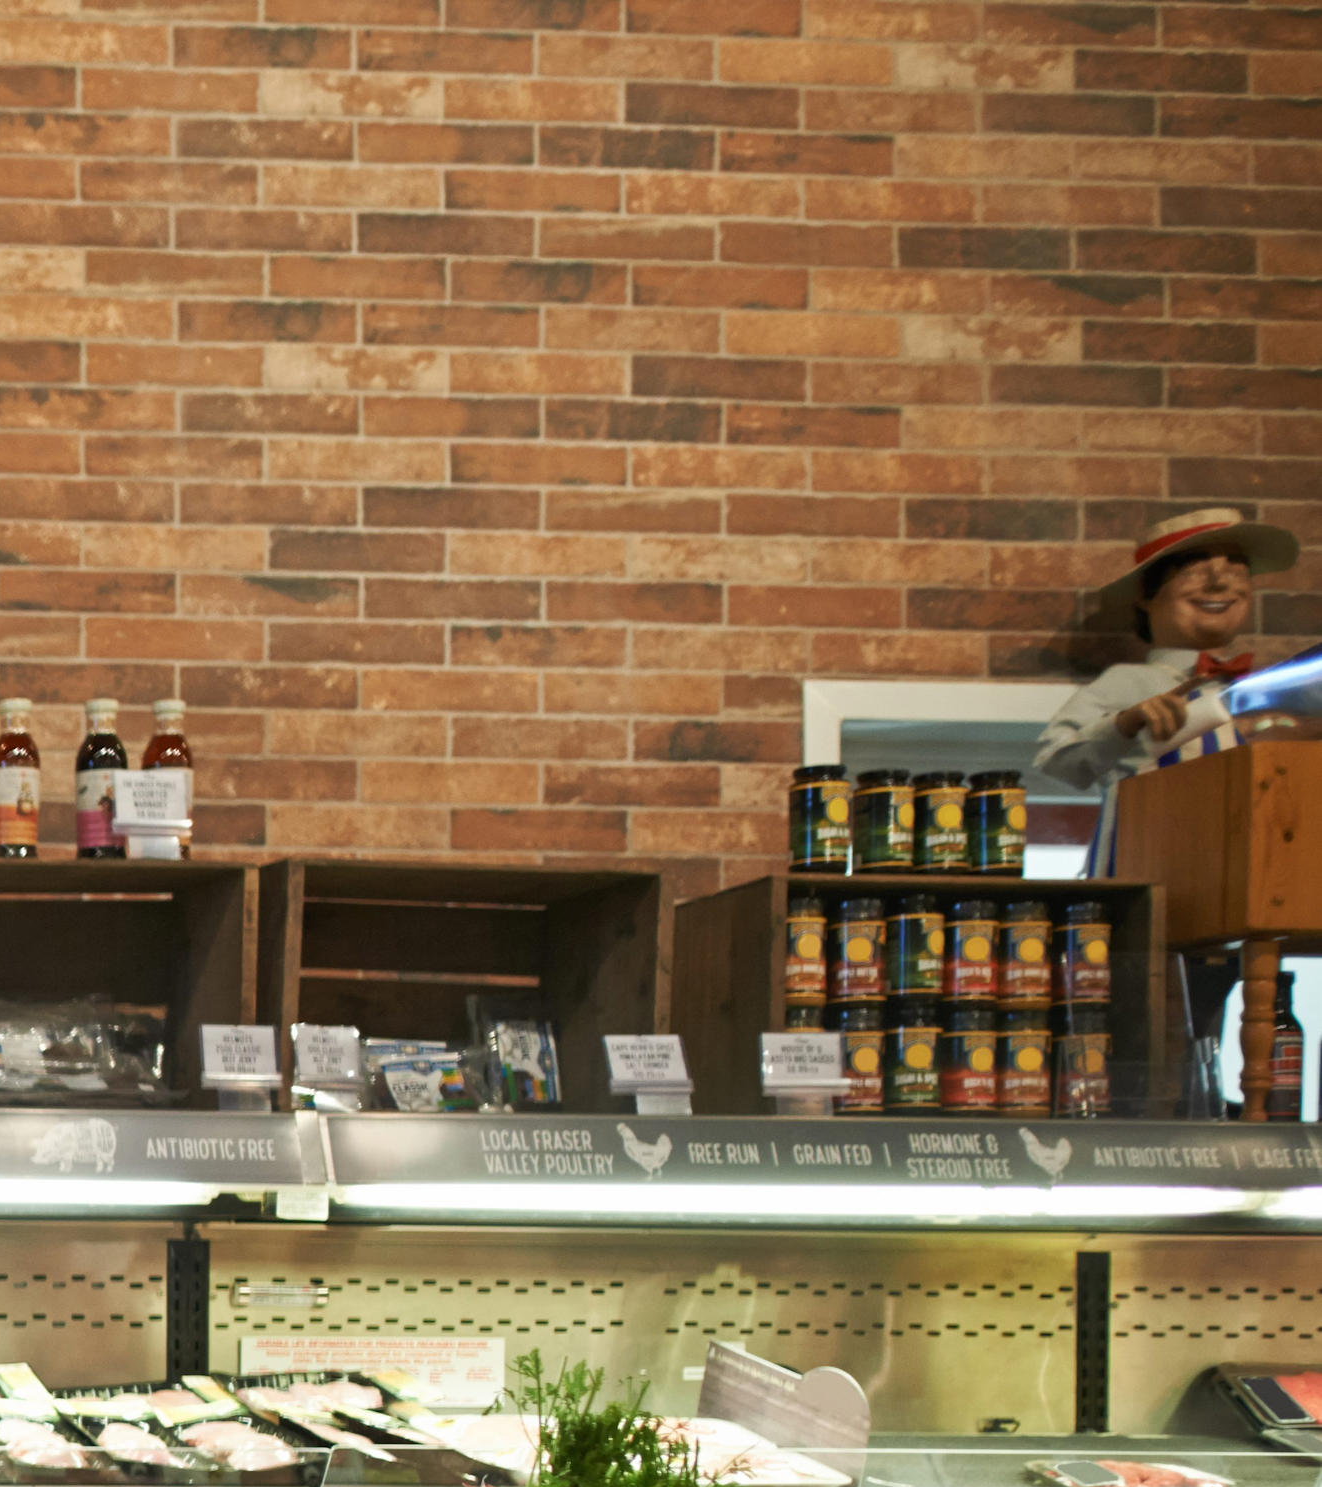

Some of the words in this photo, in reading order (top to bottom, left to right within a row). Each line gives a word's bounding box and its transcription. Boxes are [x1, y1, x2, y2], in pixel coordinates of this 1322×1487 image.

[146, 1137, 236, 1161] ANTIBIOTIC
[239, 1138, 277, 1162] FREE
[481, 1130, 530, 1152] LOCAL
[532, 1130, 594, 1152] FRASER
[909, 1133, 984, 1155] HORMONE
[986, 1134, 999, 1155] &
[485, 1153, 540, 1176] VALLEY
[545, 1153, 614, 1176] POULTRY
[688, 1142, 723, 1165] FREE
[726, 1143, 761, 1165] RUN
[793, 1144, 837, 1166] GRAIN
[838, 1144, 873, 1167] FED
[1093, 1146, 1182, 1168] ANTIBIOTIC
[1182, 1147, 1223, 1169] FREE
[1252, 1147, 1294, 1169] CAGE
[1295, 1147, 1322, 1169] FRE
[907, 1157, 972, 1179] STEROID
[974, 1158, 1013, 1180] FREE
